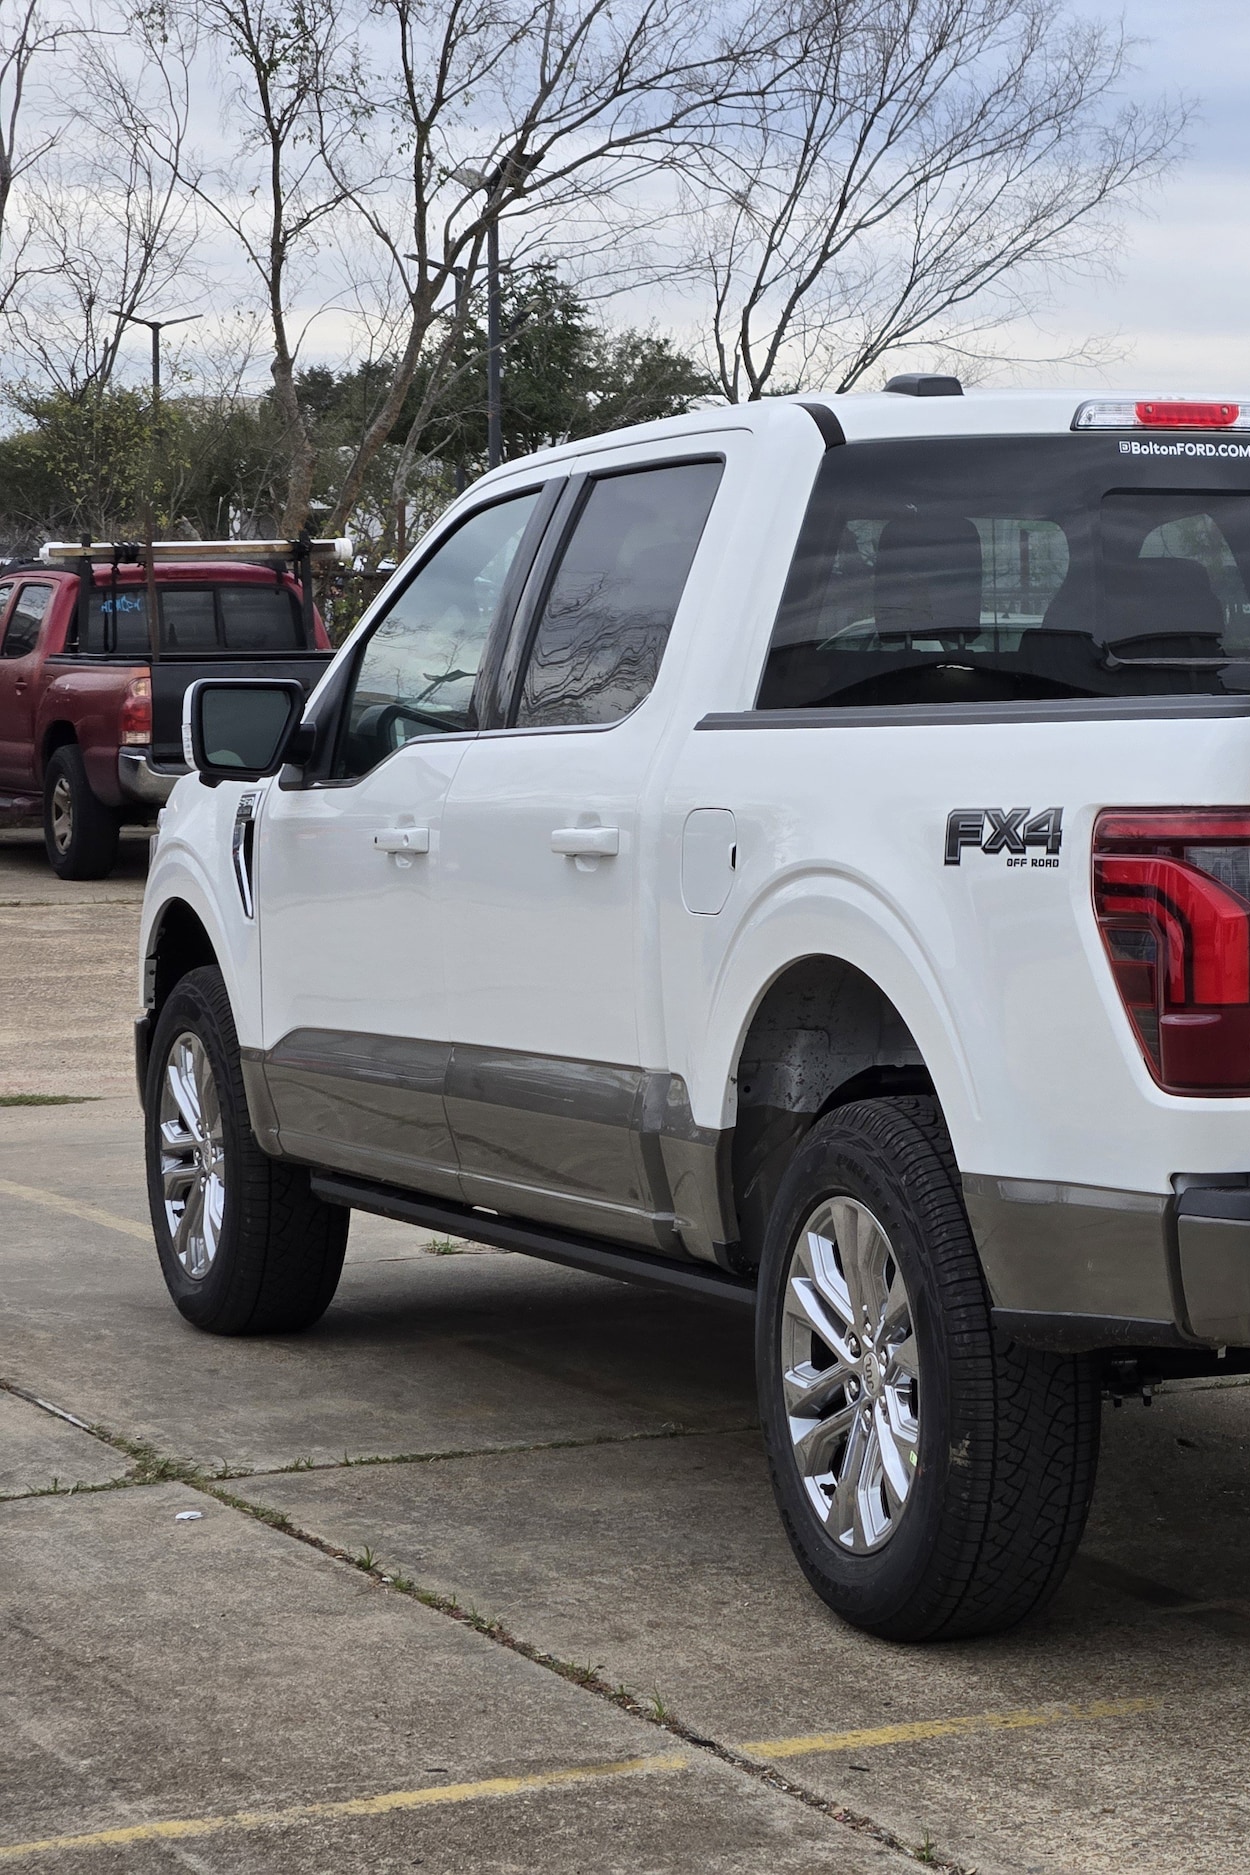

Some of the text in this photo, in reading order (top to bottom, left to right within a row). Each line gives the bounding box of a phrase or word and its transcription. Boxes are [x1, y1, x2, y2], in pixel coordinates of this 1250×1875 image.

[944, 806, 1064, 866] FX4
[1006, 858, 1060, 868] OFF ROAD
